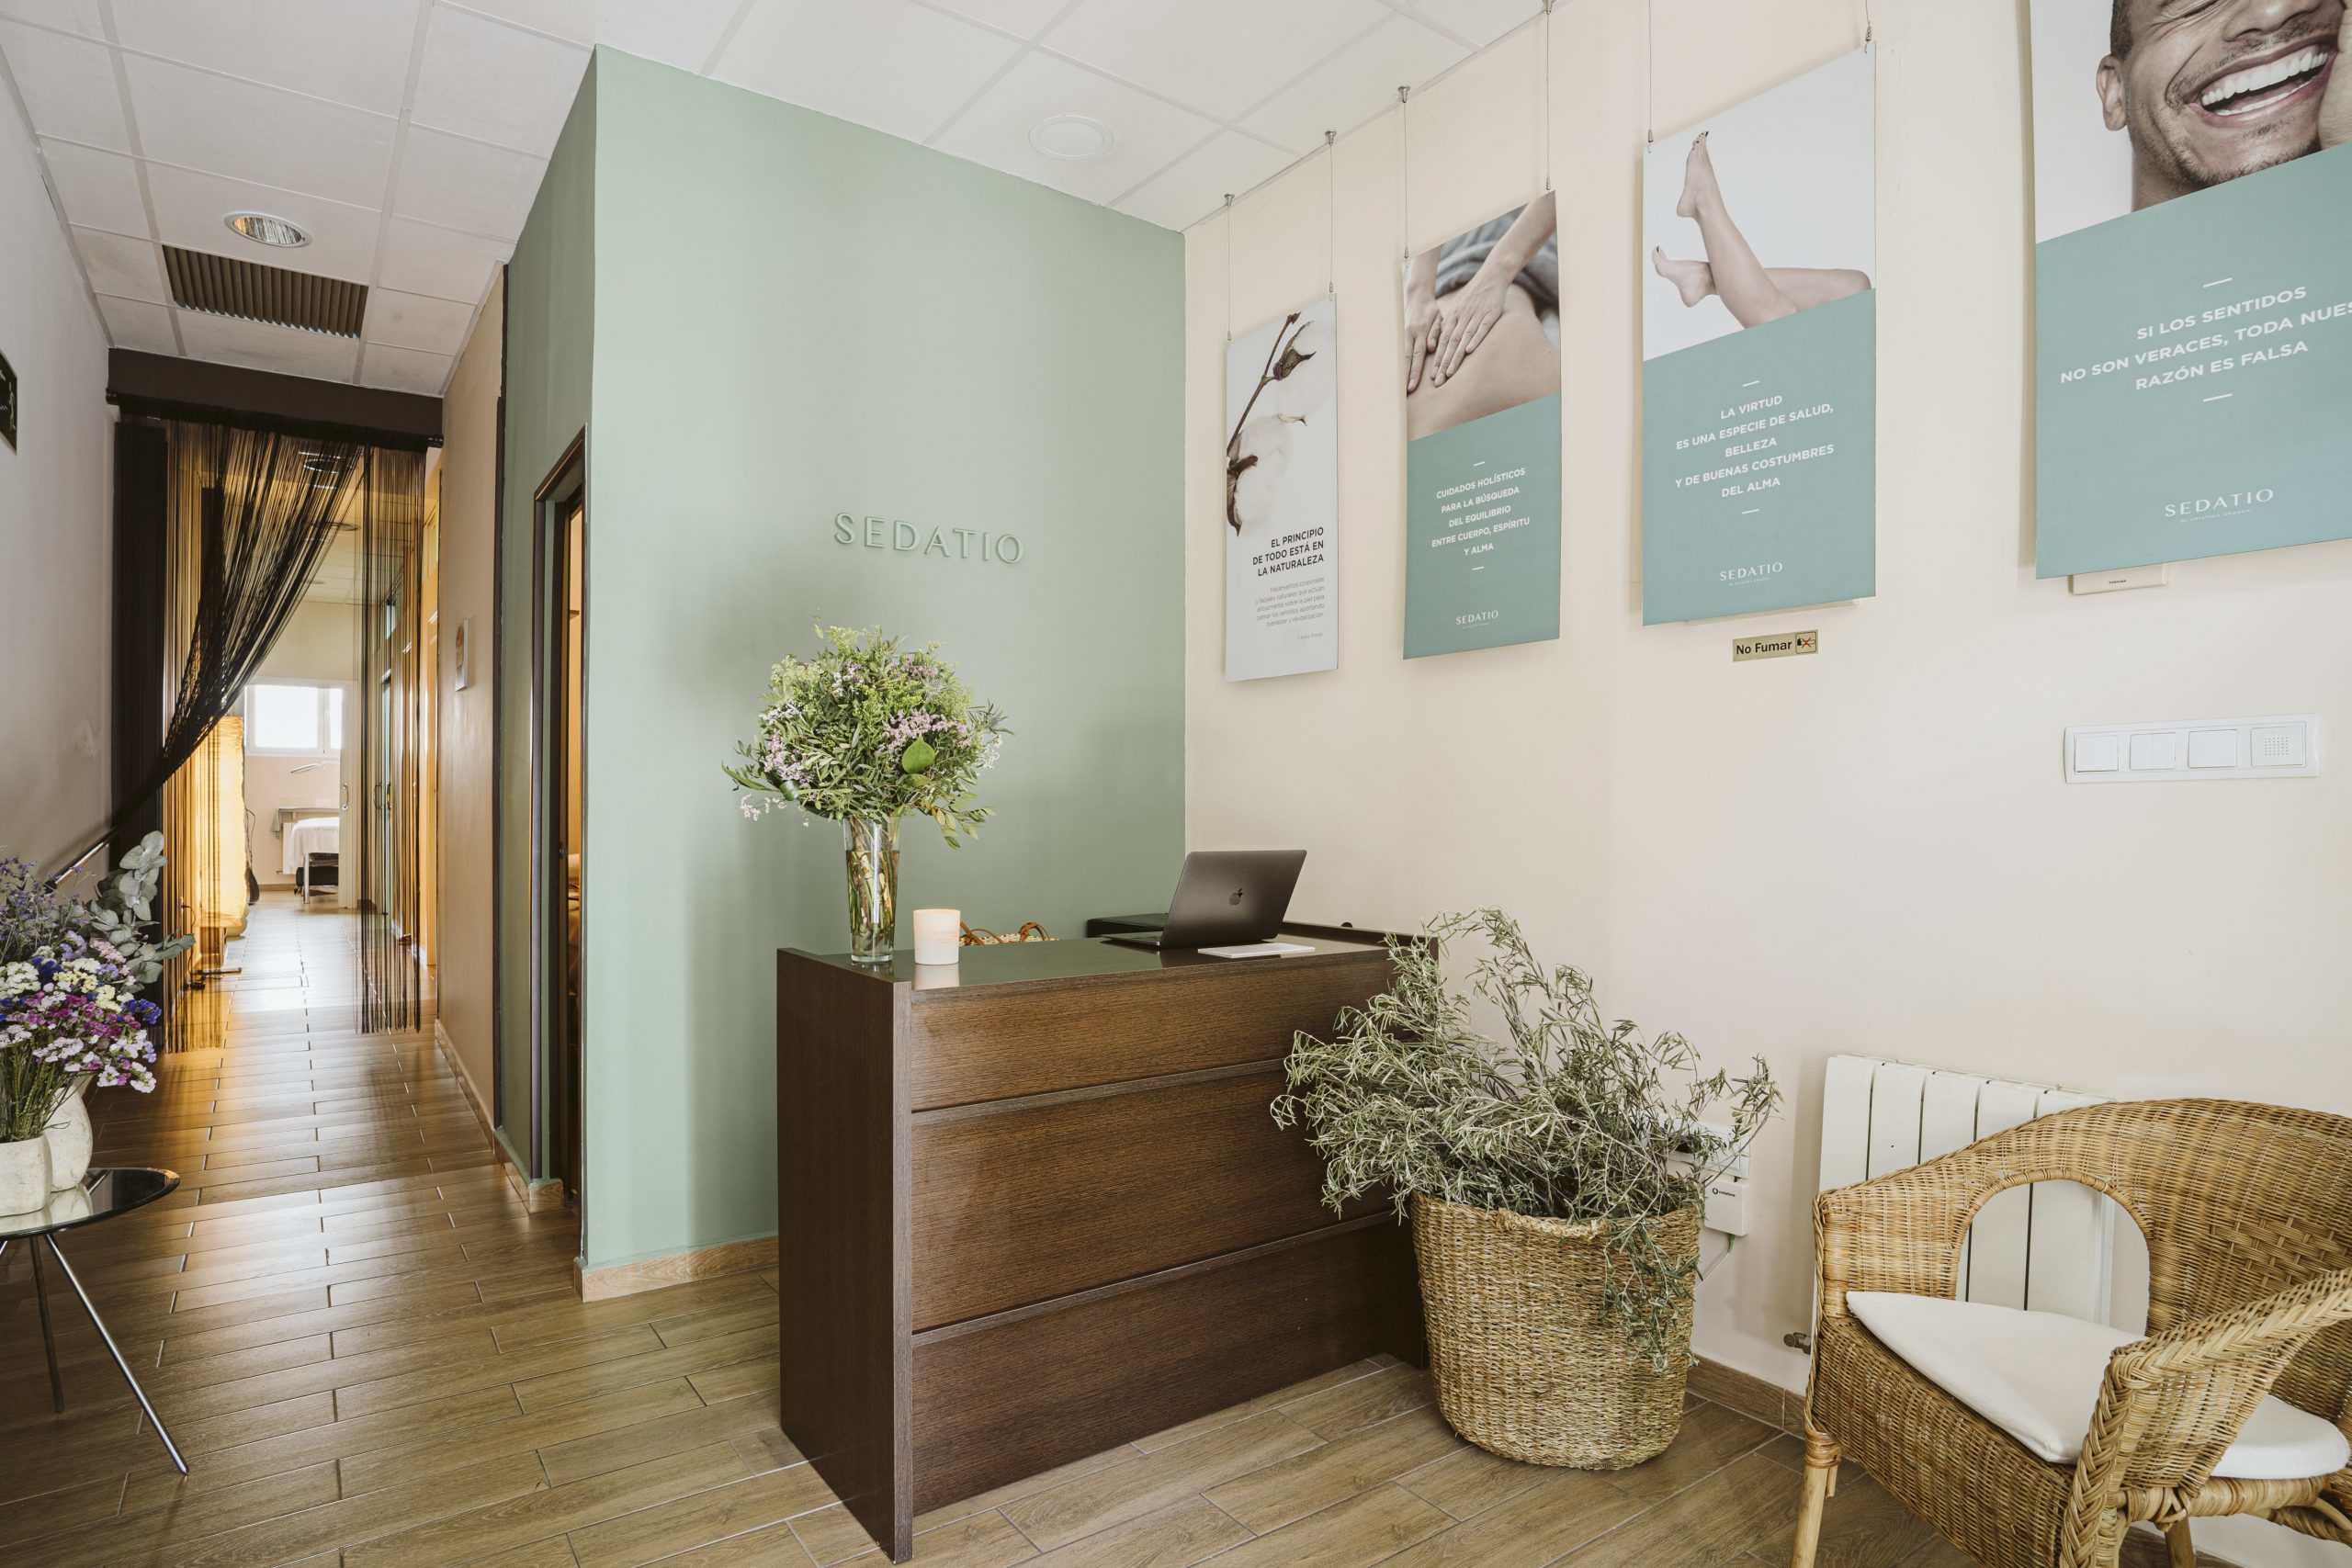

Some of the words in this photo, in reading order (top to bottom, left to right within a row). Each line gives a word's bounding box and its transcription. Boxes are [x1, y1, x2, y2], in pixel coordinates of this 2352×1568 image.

[2137, 327, 2153, 340] SI
[2160, 315, 2196, 334] LOS
[2201, 286, 2307, 323] SENTIDOS
[2060, 368, 2086, 384] NO
[2091, 357, 2129, 376] SON
[2134, 334, 2229, 366] VERACES,
[2234, 317, 2293, 342] TODA
[2136, 365, 2204, 390] RAZÓN
[2211, 358, 2234, 373] ES
[2241, 341, 2308, 366] FALSA
[1720, 407, 1735, 419] LA
[1739, 395, 1782, 414] VIRTUD
[1676, 440, 1689, 450] ES
[1692, 434, 1716, 446] UNA
[1719, 420, 1766, 440] ESPECIE
[1770, 416, 1786, 428] DE
[1789, 404, 1834, 422] SALUD,
[1725, 437, 1777, 458] BELLEZA
[1675, 478, 1682, 488] Y
[1685, 475, 1700, 487] DE
[1703, 464, 1748, 483] BUENAS
[1751, 444, 1835, 471] COSTUMBRES
[1436, 481, 1476, 499] CUIDADOS
[1477, 468, 1526, 488] HOLÍSTICOS
[1721, 485, 1743, 498] DEL
[1747, 477, 1781, 493] ALMA
[1441, 502, 1462, 514] PARA
[1463, 499, 1473, 508] LA
[1476, 486, 1520, 505] BÚSQUEDA
[2165, 488, 2274, 517] SEDATIO
[1448, 517, 1464, 528] DEL
[1465, 506, 1511, 524] EQUILIBRIO
[834, 513, 1023, 564] SEDATIO
[1271, 539, 1280, 548] EL
[1283, 527, 1324, 545] PRINCIPIO
[1431, 535, 1456, 548] ENTRE
[1458, 527, 1492, 542] CUERPO,
[1493, 517, 1530, 533] ESPÍRITU
[1253, 555, 1263, 566] DE
[1265, 549, 1287, 562] TODO
[1312, 540, 1324, 551] EN
[1471, 542, 1494, 555] ALMA
[1258, 567, 1268, 577] LA
[1270, 554, 1324, 574] NATURALEZA
[1719, 562, 1783, 581] SEDATIO
[1455, 610, 1498, 625] SEDATIO
[1736, 645, 1752, 655] No
[1755, 641, 1792, 653] Fumar
